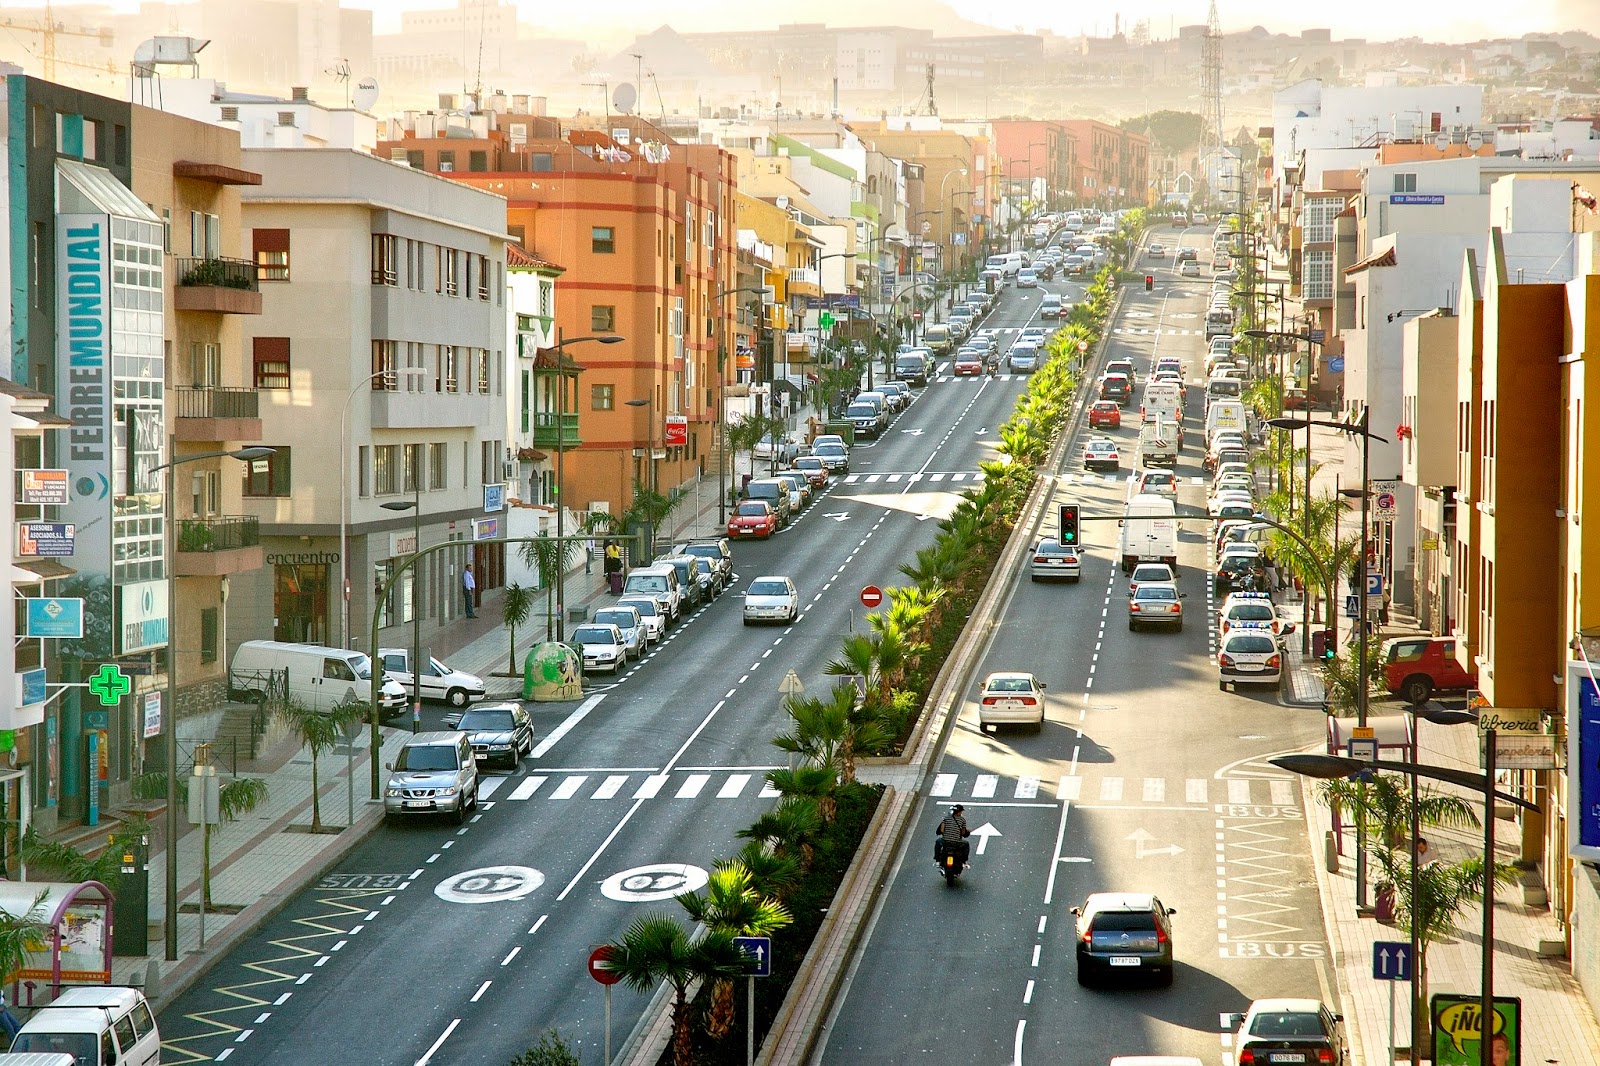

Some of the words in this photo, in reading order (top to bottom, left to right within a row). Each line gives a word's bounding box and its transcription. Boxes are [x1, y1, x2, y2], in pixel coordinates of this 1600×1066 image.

[66, 223, 103, 461] FERREMUNDIAL
[266, 550, 340, 564] encuentro
[1366, 576, 1379, 594] P
[1228, 805, 1303, 818] BUS
[1236, 942, 1326, 957] BUS
